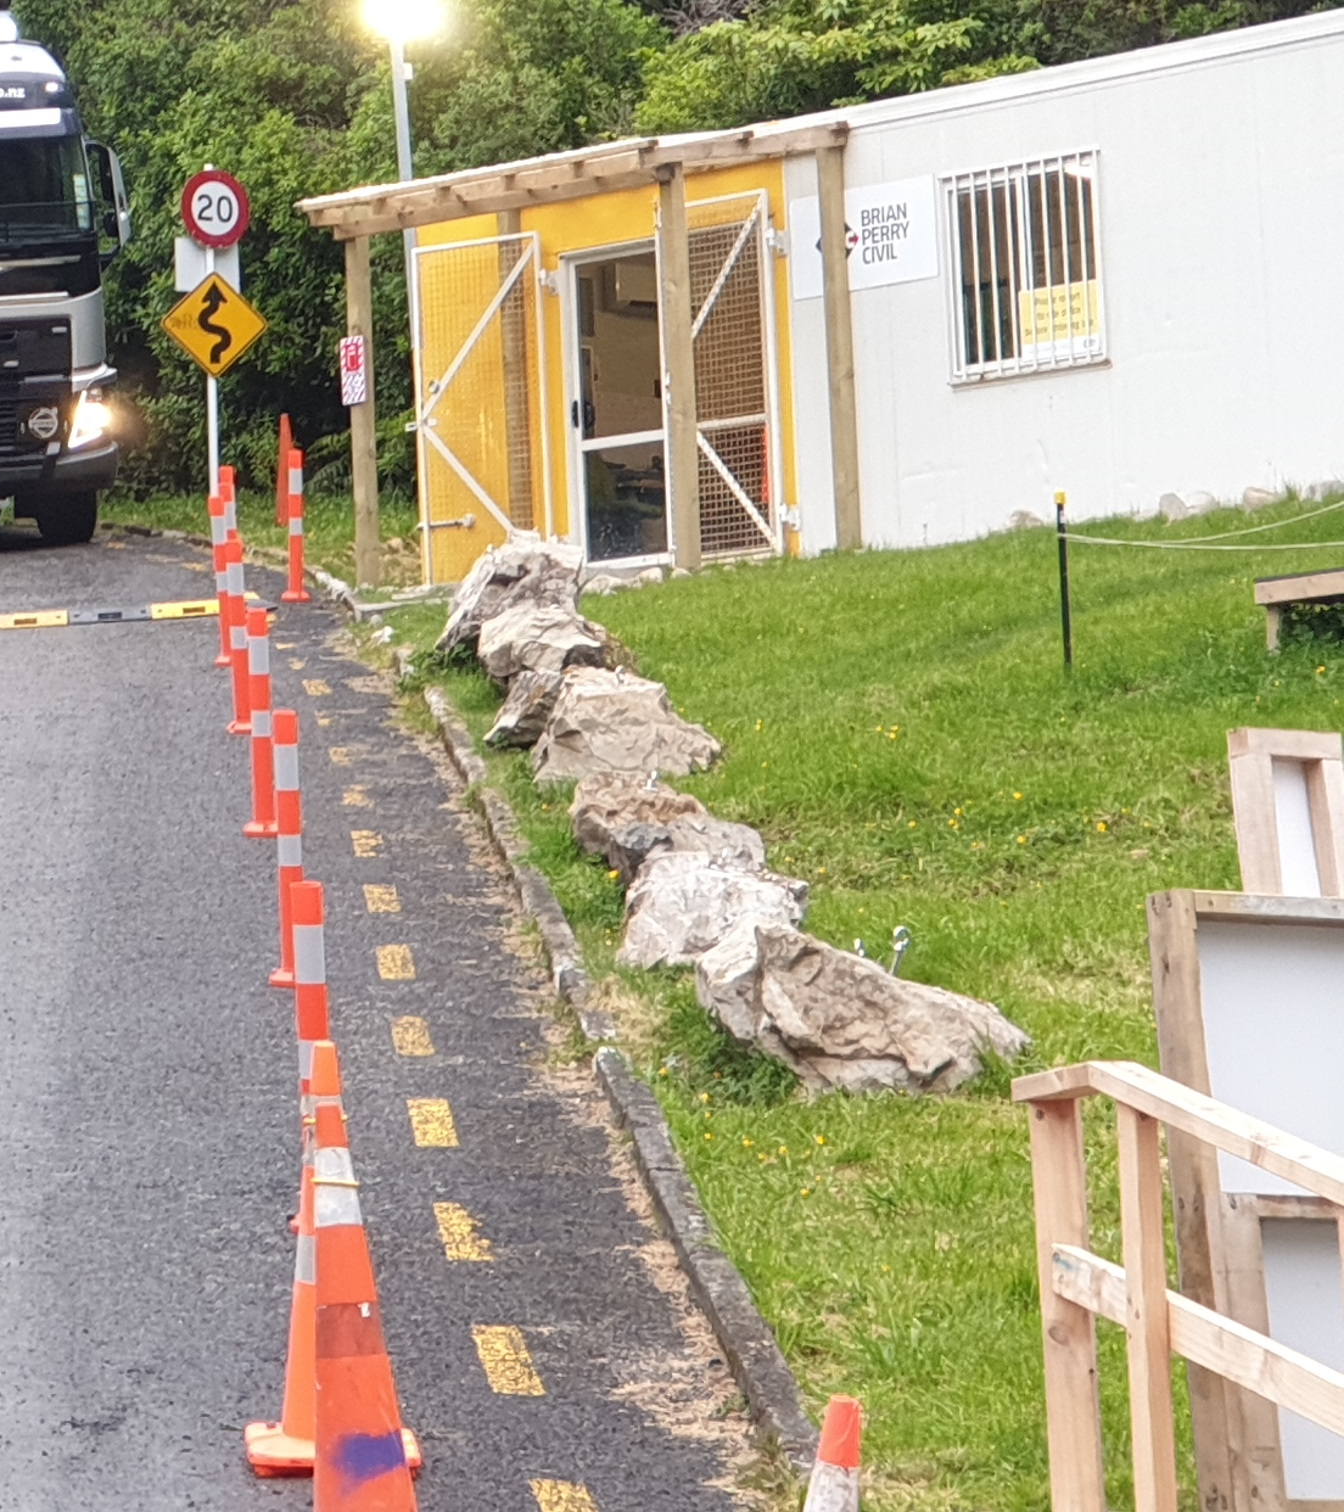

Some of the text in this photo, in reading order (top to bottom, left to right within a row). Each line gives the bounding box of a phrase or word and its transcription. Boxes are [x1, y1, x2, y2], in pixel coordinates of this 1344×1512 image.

[197, 194, 233, 223] 20
[861, 202, 907, 227] BRIAN
[861, 220, 910, 246] PERRY
[862, 243, 898, 265] CIVIL
